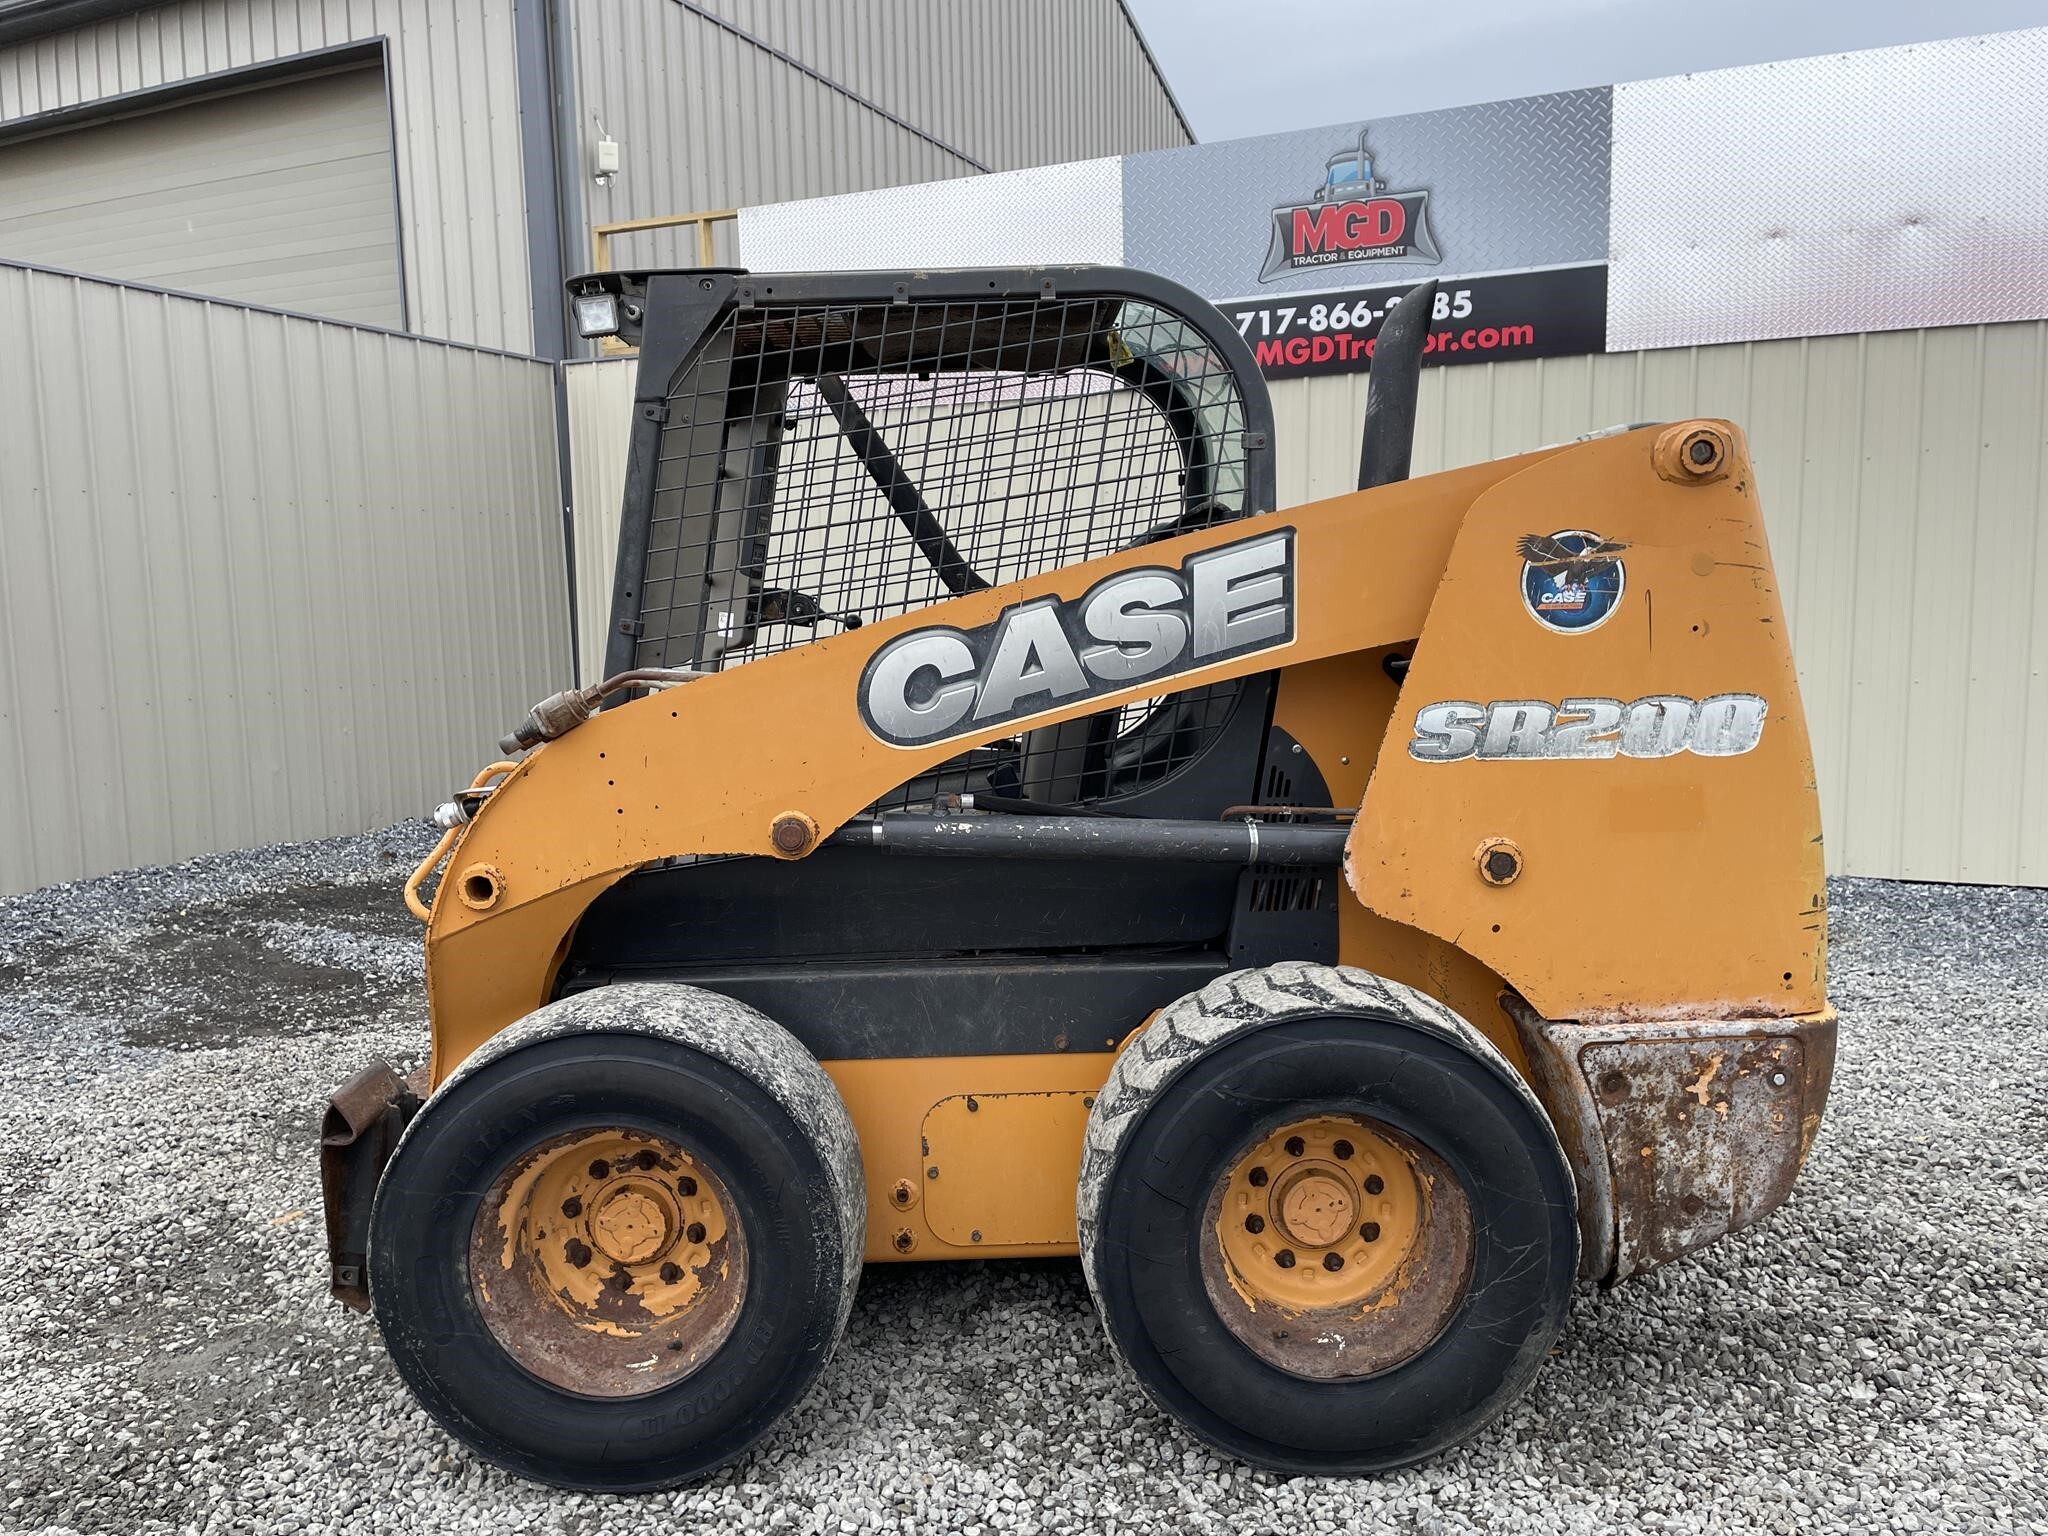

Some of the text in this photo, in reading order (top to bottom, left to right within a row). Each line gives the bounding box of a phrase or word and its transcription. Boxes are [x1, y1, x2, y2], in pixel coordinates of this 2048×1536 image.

[1293, 199, 1406, 255] MGD
[1293, 246, 1405, 266] TRACTOR & EQUIPMENT
[1236, 290, 1473, 337] 717-866-85
[1255, 324, 1534, 368] MGDTrr.com
[1541, 590, 1587, 603] CASE
[867, 537, 1288, 740] CASE
[1409, 694, 1768, 762] SR200
